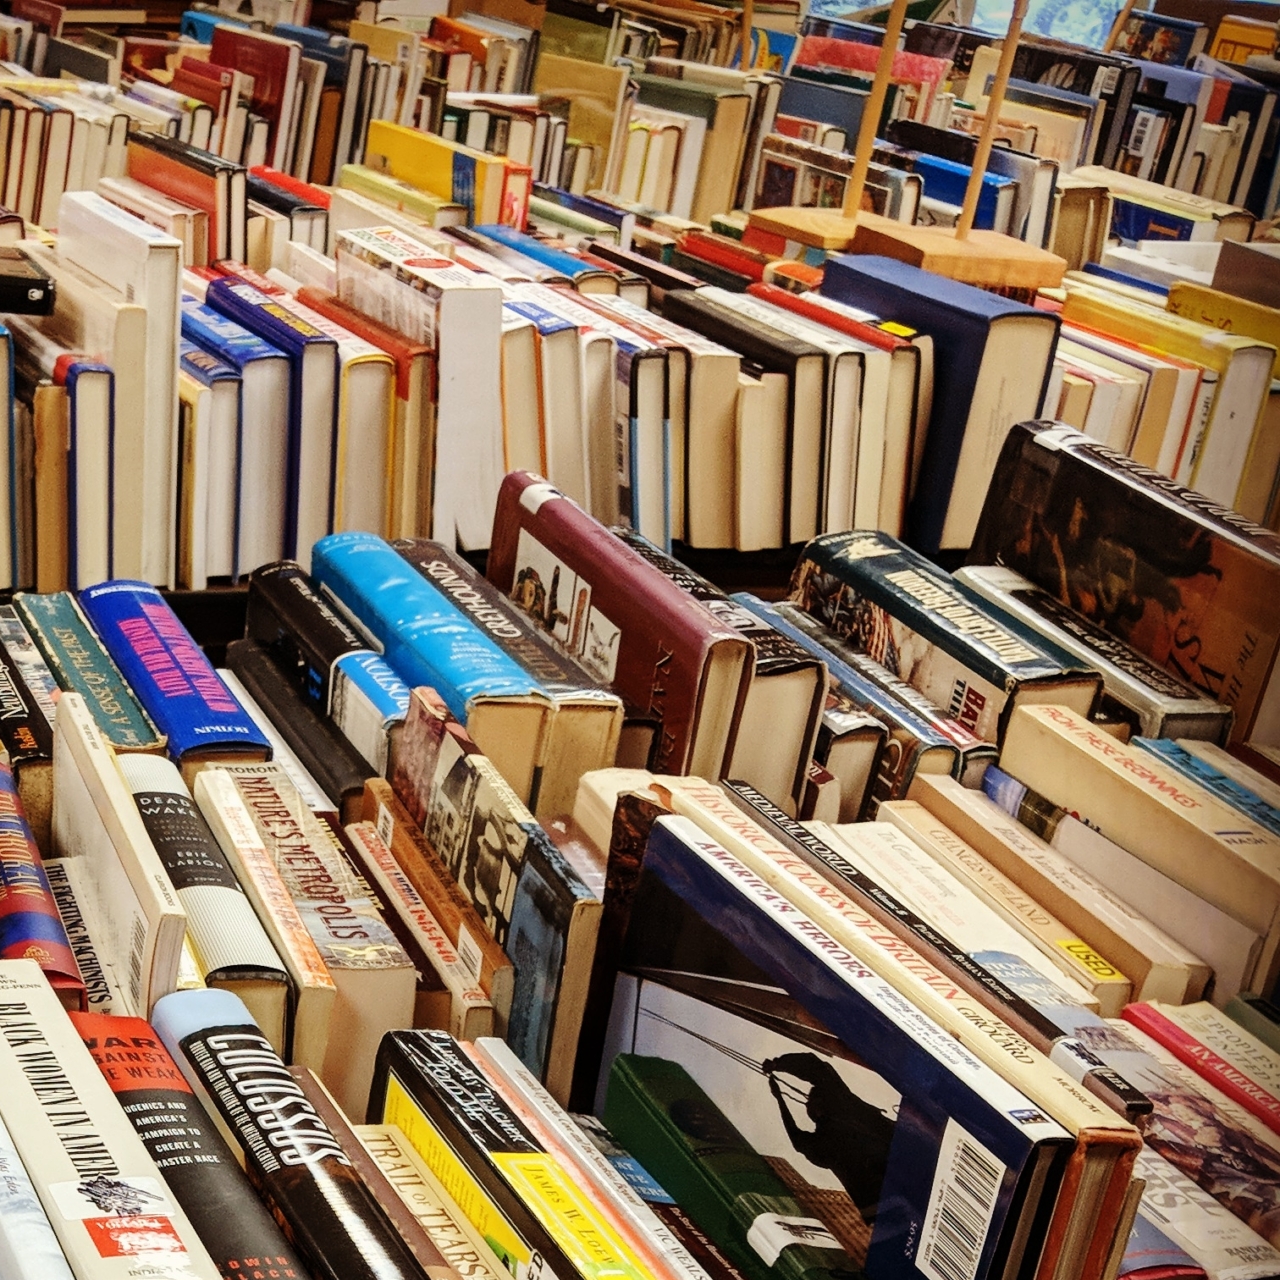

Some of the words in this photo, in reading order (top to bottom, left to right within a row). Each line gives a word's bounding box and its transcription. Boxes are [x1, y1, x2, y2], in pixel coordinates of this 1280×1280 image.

[421, 560, 523, 639] GREYHOUNDS
[1038, 706, 1080, 731] FROM
[1074, 728, 1123, 757] THESE
[1115, 752, 1204, 809] BEGINNINGS
[139, 796, 191, 808] DEAD
[141, 805, 198, 819] WAKE
[176, 851, 209, 859] ERIK
[236, 776, 304, 839] NATURE'S
[277, 838, 370, 941] METROPOLIS
[1225, 838, 1269, 847] NASH
[168, 859, 224, 870] LARSON
[680, 783, 767, 853] HISTORIC
[770, 850, 848, 912] HOUSES
[839, 906, 878, 936] OF
[868, 930, 967, 1004] BRITAIN
[695, 841, 796, 915] AMERICA'S
[790, 919, 876, 980] HEROES
[1066, 944, 1116, 977] USED
[957, 1006, 1034, 1065] GIROUARD
[126, 1066, 179, 1082] WEAK
[207, 1033, 351, 1167] COLOSSUS
[1053, 1076, 1105, 1116] MORROW
[136, 1113, 187, 1126] AMERICA'S
[155, 1155, 193, 1169] MASTER
[196, 1153, 221, 1165] RACE
[363, 1133, 418, 1199] TRAIL
[3, 1173, 20, 1197] Eden
[412, 1192, 431, 1206] OF
[519, 1166, 565, 1204] JAMES
[563, 1208, 581, 1227] W.
[577, 1229, 618, 1266] LOEW
[420, 1196, 490, 1280] TEARS
[653, 1227, 675, 1248] VIC
